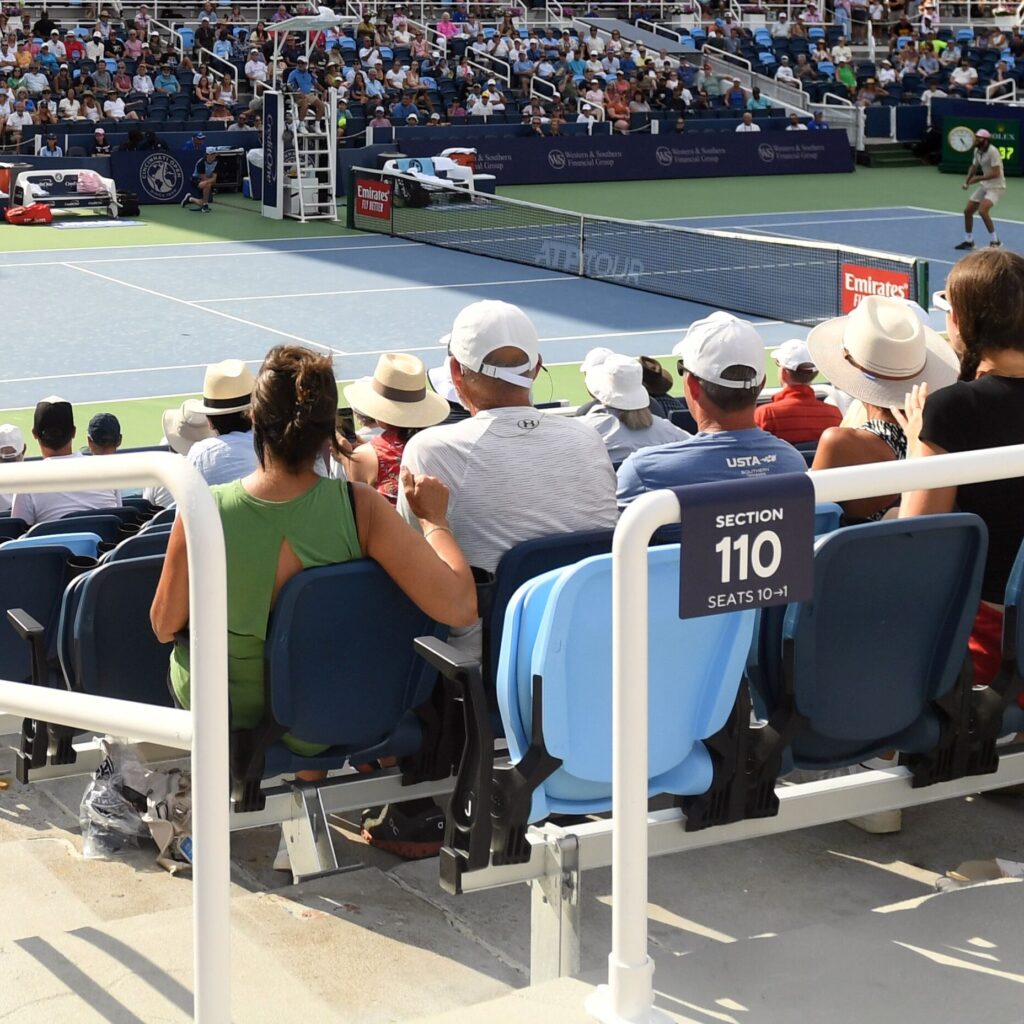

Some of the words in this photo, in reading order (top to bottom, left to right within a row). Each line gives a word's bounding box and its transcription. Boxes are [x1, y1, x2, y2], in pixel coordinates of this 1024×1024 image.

[484, 162, 504, 170] Group
[357, 184, 389, 202] Emirates
[845, 272, 905, 298] Emirates
[726, 456, 761, 468] USTA
[716, 508, 784, 528] SECTION
[715, 530, 782, 583] 110
[708, 590, 754, 609] SEATS
[464, 799, 472, 817] J
